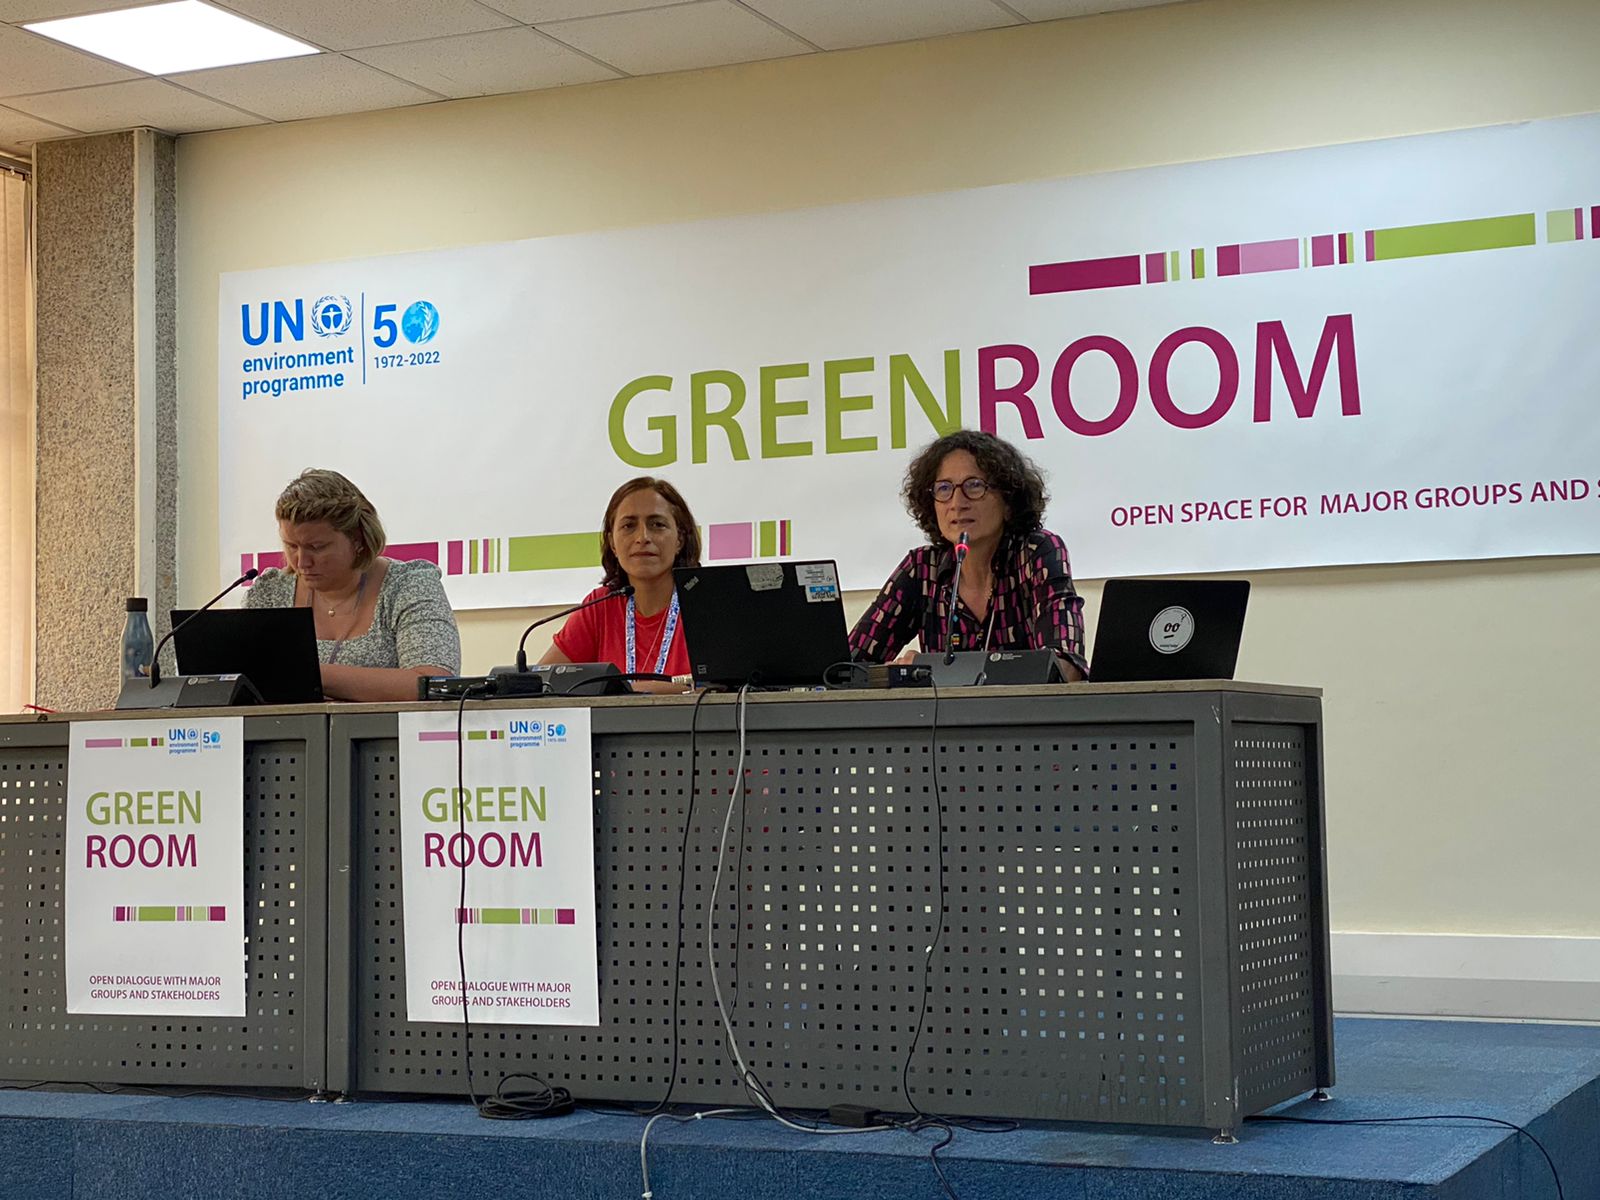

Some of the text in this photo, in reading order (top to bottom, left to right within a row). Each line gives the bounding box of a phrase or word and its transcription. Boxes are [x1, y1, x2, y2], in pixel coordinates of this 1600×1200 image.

[241, 299, 304, 346] UN
[243, 346, 354, 372] environment
[374, 351, 440, 368] 1972-2022
[243, 371, 344, 400] programme
[1111, 504, 1174, 526] OPEN
[1181, 499, 1253, 522] SPACE
[1260, 496, 1308, 517] FOR
[1320, 490, 1408, 515] MAJOR
[1415, 483, 1523, 508] GROUPS
[1530, 479, 1590, 502] AND
[169, 729, 186, 740] UN
[509, 721, 528, 733] UN
[86, 790, 202, 825] GREEN
[421, 786, 547, 822] GREEN
[86, 834, 197, 868] ROOM
[424, 832, 543, 868] ROOM
[89, 975, 221, 986] OPEN DIALOGUE WITH MAJOR
[430, 980, 456, 990] OPEN
[509, 982, 535, 992] WITH
[536, 982, 571, 992] MAJOR
[90, 989, 220, 1000] GROUPS AND STAKEHOLDERS
[472, 996, 494, 1006] AND
[496, 996, 571, 1008] STAKEHOLDERS
